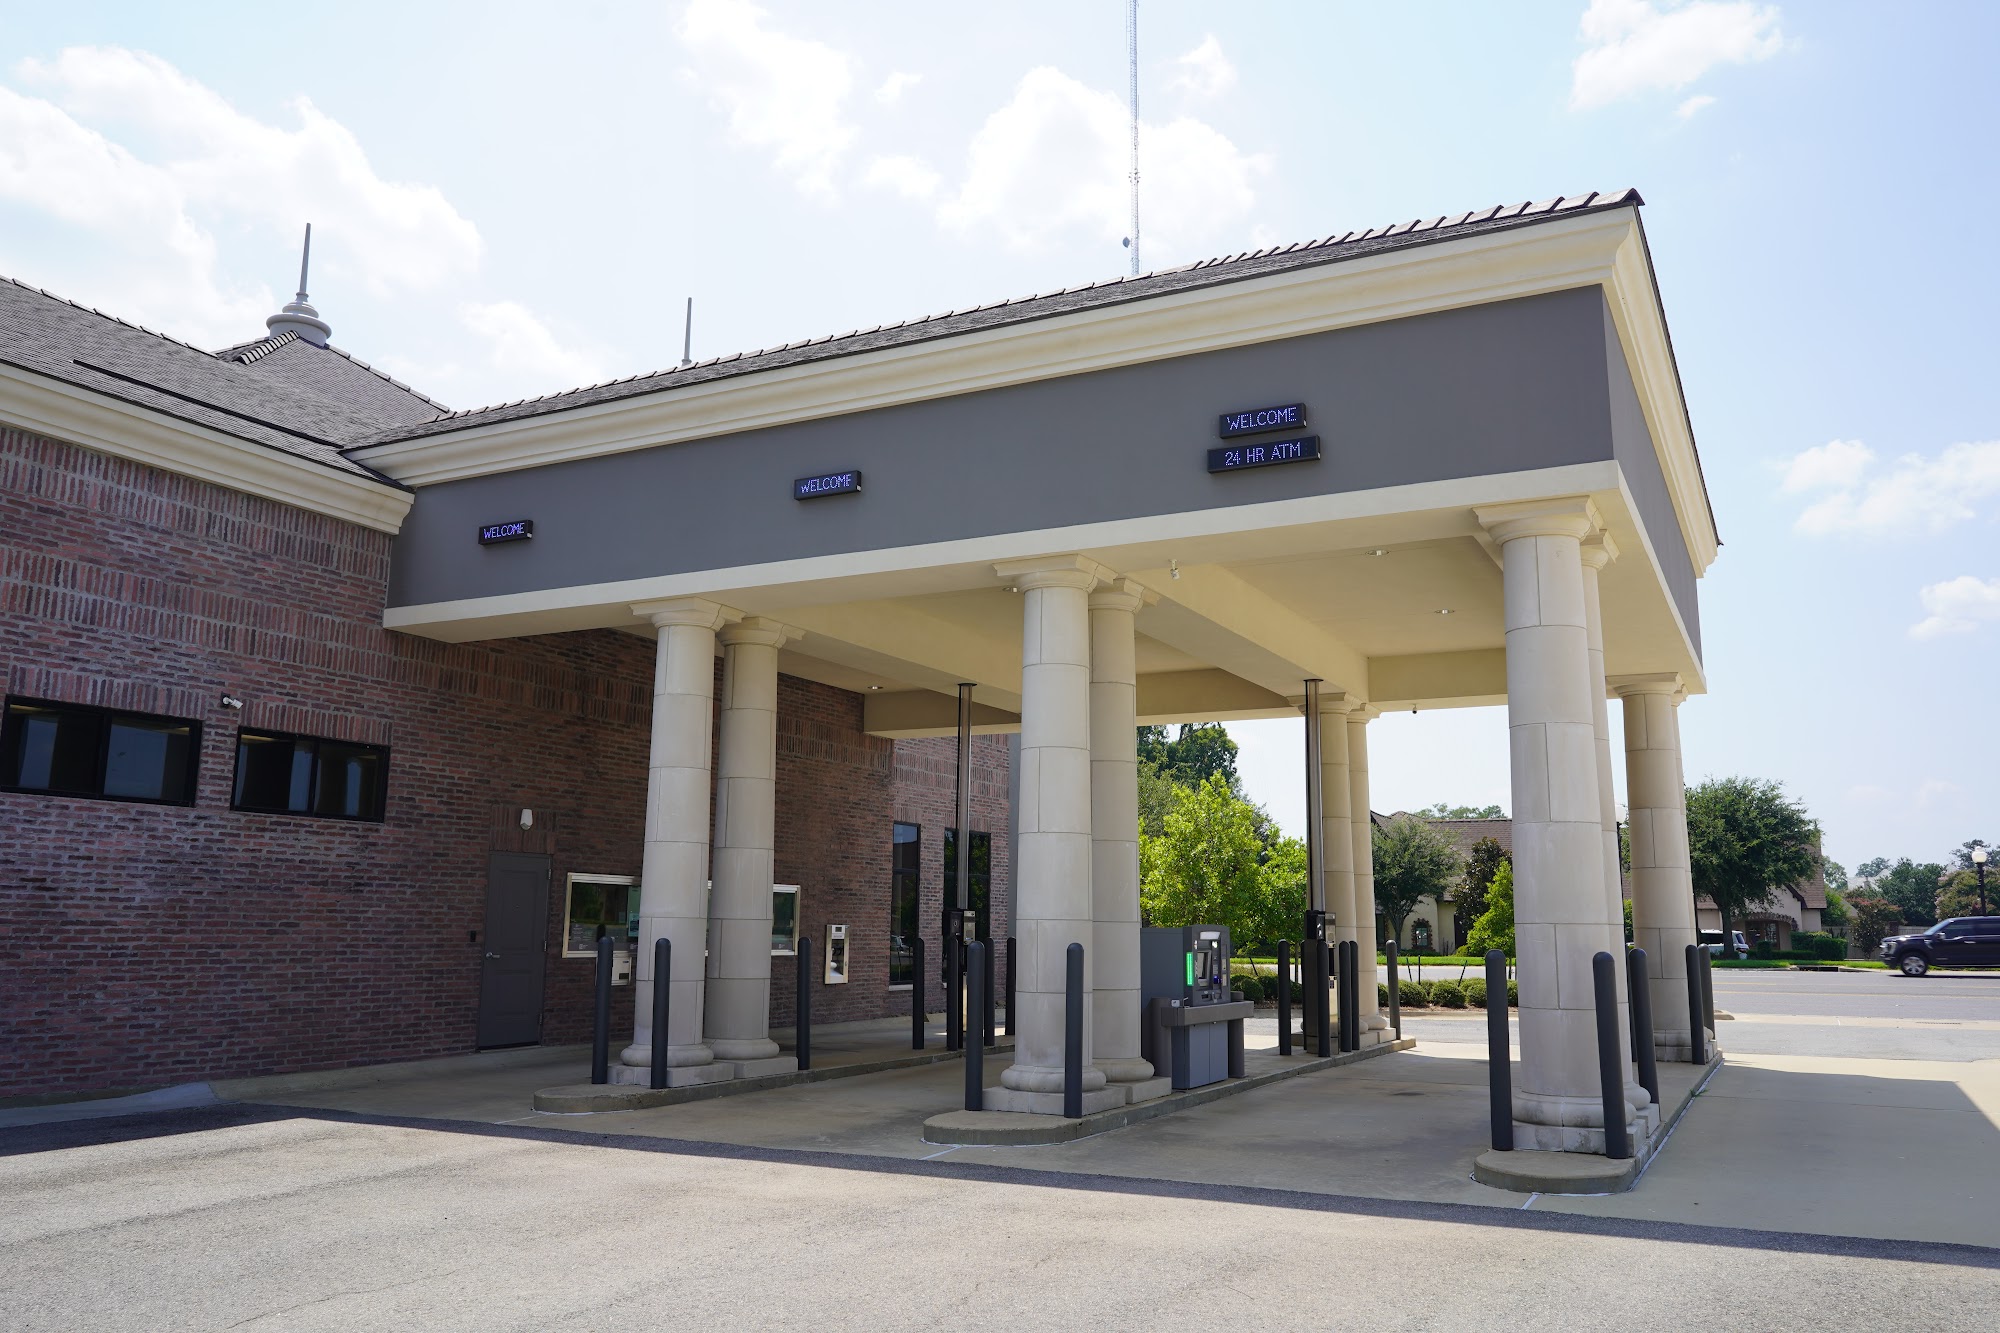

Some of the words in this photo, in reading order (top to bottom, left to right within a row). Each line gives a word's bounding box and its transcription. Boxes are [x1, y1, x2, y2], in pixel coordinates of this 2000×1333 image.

[1226, 406, 1297, 430] WELCOME
[1225, 450, 1241, 466] 24
[1246, 447, 1265, 463] HR
[1270, 441, 1301, 460] ATM
[801, 473, 852, 494] WELCOME
[483, 522, 525, 540] WELCOME
